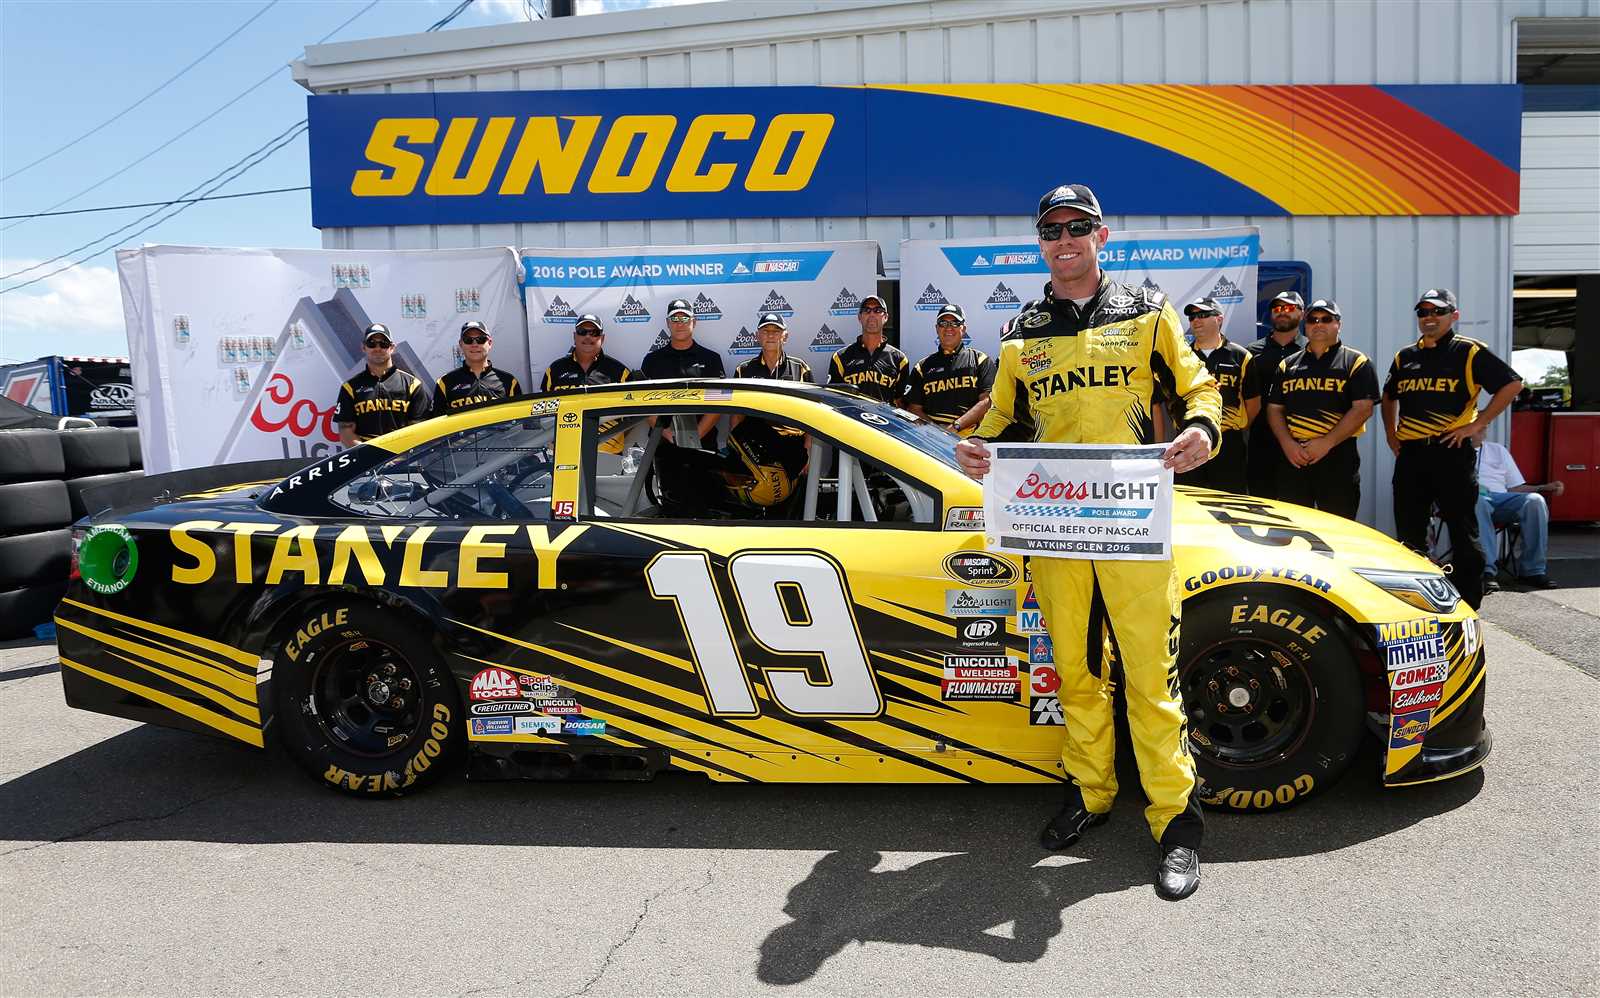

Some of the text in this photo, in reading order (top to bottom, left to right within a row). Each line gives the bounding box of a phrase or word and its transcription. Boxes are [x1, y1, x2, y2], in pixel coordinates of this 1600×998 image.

[350, 113, 836, 196] SUNOCO
[1008, 255, 1038, 265] NASCAR
[1097, 245, 1250, 262] OLE AWARD WINNER
[533, 262, 724, 279] 2016 POLE AWARD WINNER
[768, 260, 799, 272] NASCAR
[1104, 306, 1138, 315] TOYOTA
[1020, 343, 1053, 357] ARRIS
[1021, 351, 1047, 366] Sport
[1030, 358, 1052, 370] Clips
[844, 370, 896, 388] STANLEY
[923, 375, 978, 396] STANLEY
[1029, 365, 1138, 402] STANLEY
[1282, 377, 1346, 394] STANLEY
[1397, 377, 1460, 394] STANLEY
[250, 373, 340, 442] Coo
[354, 398, 411, 416] STANLEY
[1015, 472, 1159, 501] Coors LIGHT
[555, 502, 573, 515] J5
[1092, 509, 1138, 517] POLE AWARD
[86, 526, 132, 541] AMERICAN
[1012, 523, 1149, 537] OFFICIAL BEER OF NASCAR
[1027, 540, 1131, 552] WATKINS GLEN 2016
[170, 520, 591, 590] STANLEY
[963, 558, 991, 566] NASCAR
[967, 566, 994, 577] Sprint
[1184, 564, 1333, 594] GOODYEAR
[86, 577, 130, 593] ETHANOL
[985, 598, 1012, 607] LIGHT
[969, 623, 994, 636] IR
[1230, 604, 1327, 645] EAGLE
[1379, 618, 1438, 642] MOOG
[285, 608, 349, 662] EAGLE
[645, 549, 886, 719] 19
[1461, 616, 1477, 657] 19
[1388, 638, 1445, 666] MAHLE
[947, 657, 1005, 668] LINCOLN
[472, 669, 517, 690] MAC
[520, 674, 552, 685] Sport
[960, 669, 1011, 678] WELDERS
[1395, 665, 1437, 686] COMP
[473, 688, 518, 698] TOOLS
[531, 682, 559, 692] Clips
[945, 681, 1017, 699] FLOWMASTER
[538, 699, 574, 707] LINCOLN
[1394, 688, 1441, 709] Edelbrock
[476, 703, 530, 713] FREIGHTLINER
[520, 721, 556, 729] SIEMENS
[564, 721, 606, 729] DOOSAN
[1393, 721, 1430, 738] SUNOCO
[323, 703, 451, 793] GOODYEAR
[1198, 773, 1314, 809] GOOD
